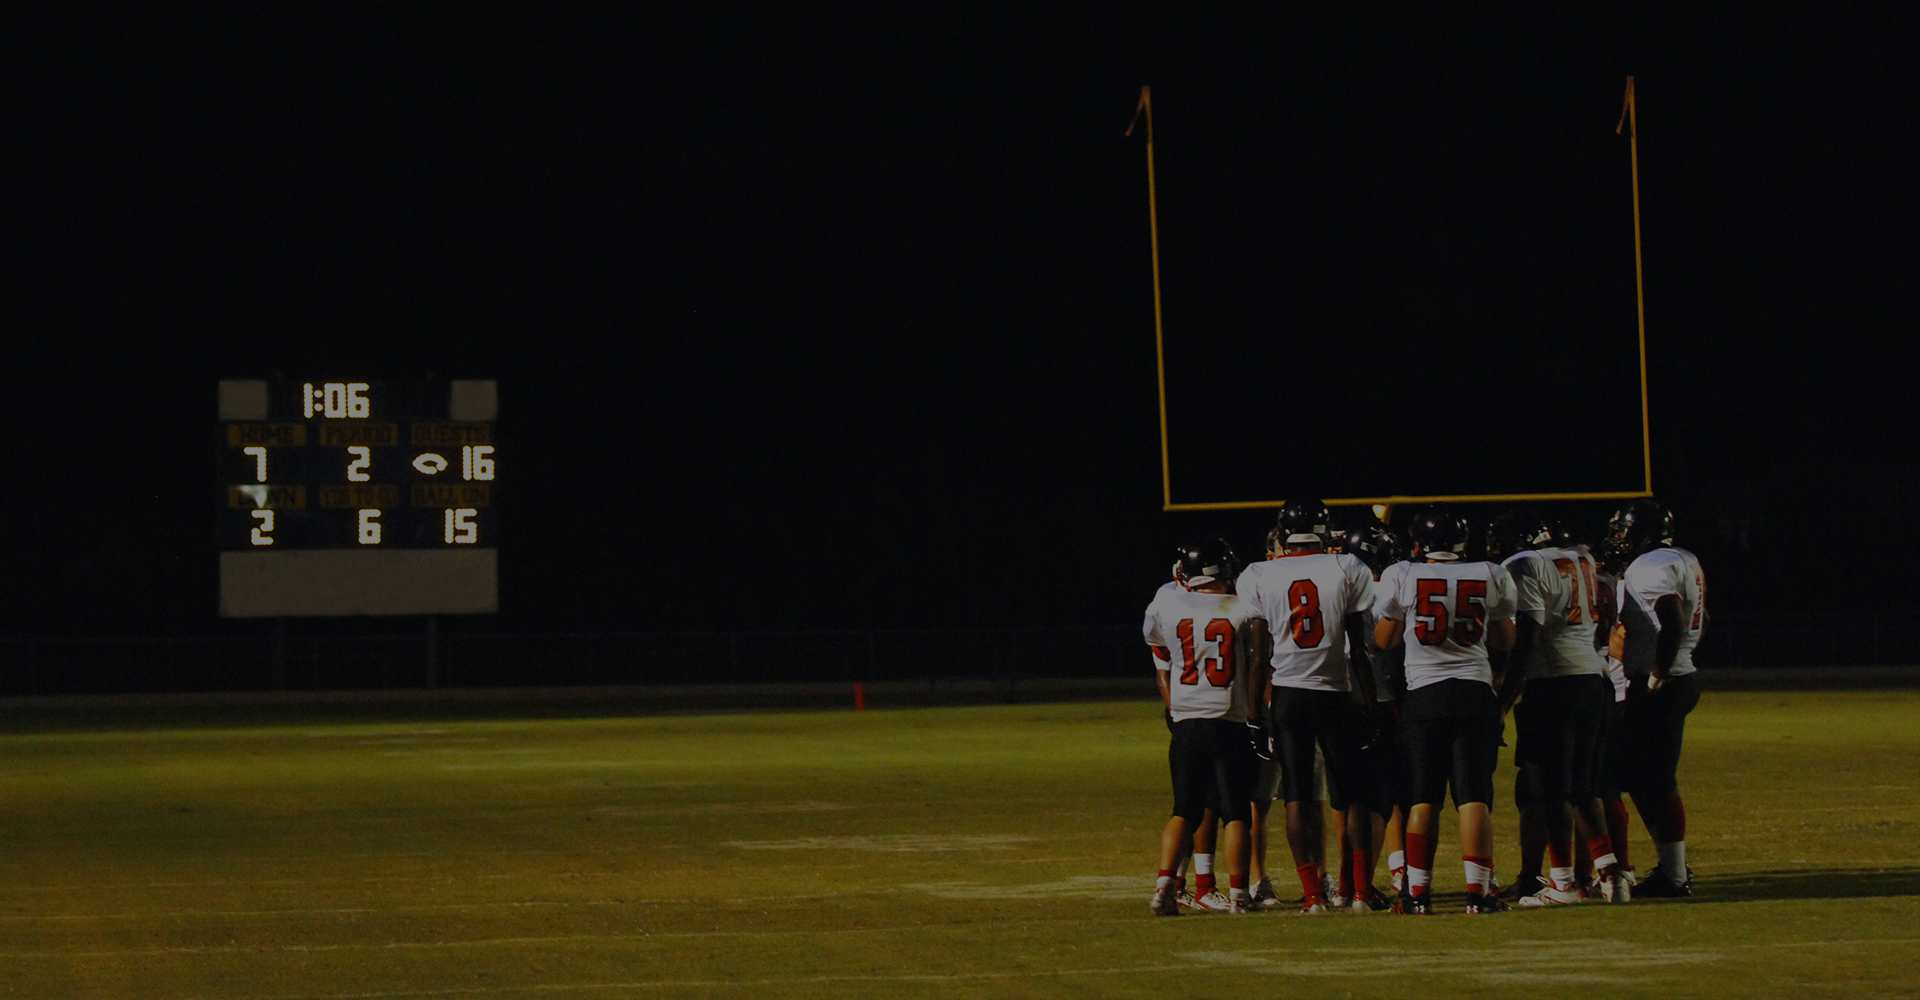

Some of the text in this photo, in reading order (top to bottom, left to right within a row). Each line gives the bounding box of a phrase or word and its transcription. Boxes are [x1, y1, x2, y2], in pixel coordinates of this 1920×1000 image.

[303, 382, 370, 419] 1:06
[243, 446, 267, 482] 7
[347, 446, 371, 482] 2
[462, 445, 495, 481] 16
[251, 509, 275, 546] 2
[358, 508, 382, 545] 6
[444, 508, 478, 545] 15
[1287, 579, 1323, 649] 8
[1414, 579, 1487, 646] 55
[1176, 618, 1236, 687] 13
